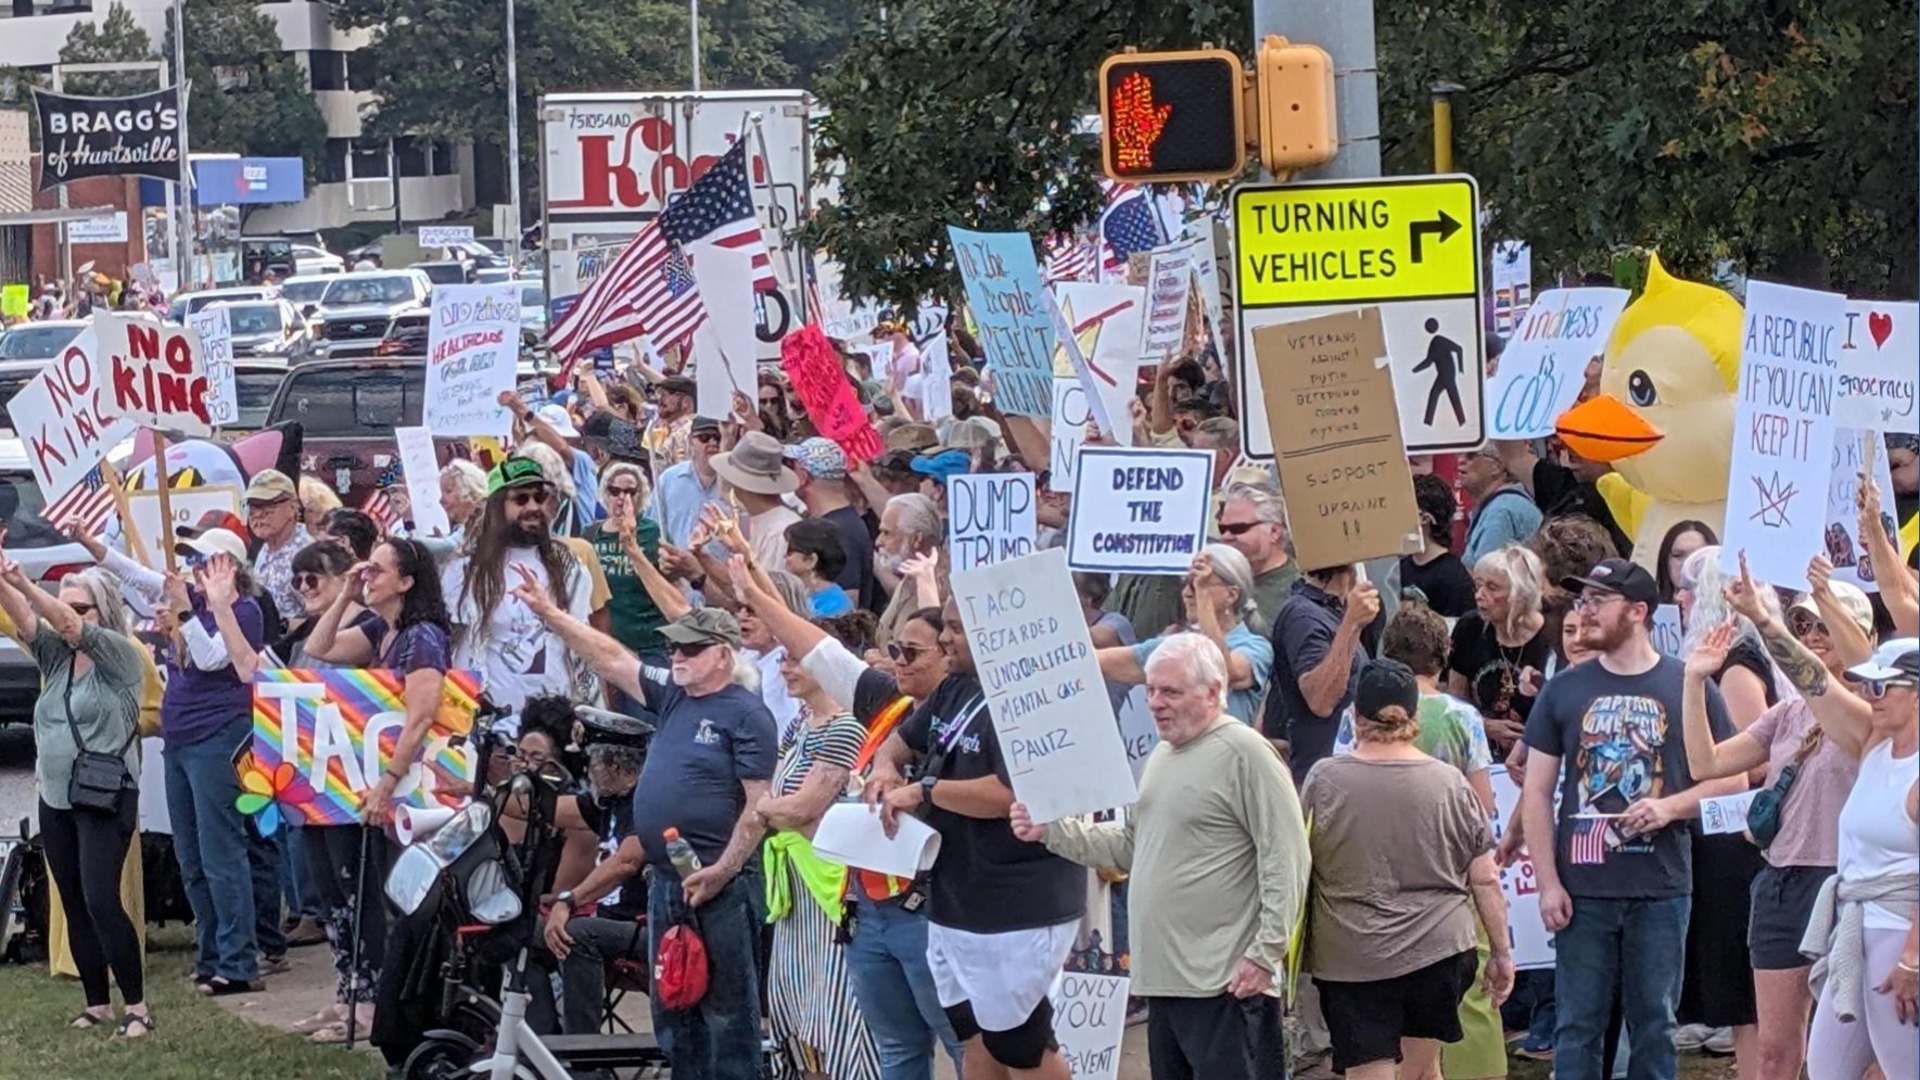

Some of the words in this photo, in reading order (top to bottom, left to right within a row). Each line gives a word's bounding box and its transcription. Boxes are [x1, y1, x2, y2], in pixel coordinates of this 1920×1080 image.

[50, 102, 177, 134] BRAGG'S
[48, 138, 68, 177] of
[73, 136, 179, 166] Huntsville
[1252, 200, 1389, 234] TURNING
[1250, 249, 1396, 283] VEHICLES
[1521, 292, 1602, 342] indness
[1746, 315, 1757, 352] A
[1842, 313, 1860, 349] I
[127, 323, 193, 374] NO
[982, 322, 1053, 374] REJECT
[43, 346, 91, 418] NO
[1745, 363, 1762, 402] IF
[1763, 366, 1795, 410] YOU
[1799, 372, 1833, 417] CAN
[1837, 374, 1915, 417] emocracy
[1495, 373, 1564, 433] COOL
[1751, 412, 1789, 458] KEEP
[1793, 418, 1815, 463] IT
[1112, 467, 1184, 491] DEFEND
[1306, 461, 1388, 488] SUPPORT
[954, 478, 1030, 534] DUMP
[1127, 501, 1163, 523] THE
[1318, 497, 1388, 517] UKRAINE
[1092, 531, 1195, 555] CONSTITUTION
[964, 586, 1026, 625] TACO
[977, 616, 1060, 657] RETARDED
[1000, 687, 1053, 724] MENTAL
[1062, 976, 1120, 1000] ONLY
[1054, 1000, 1107, 1029] YOU
